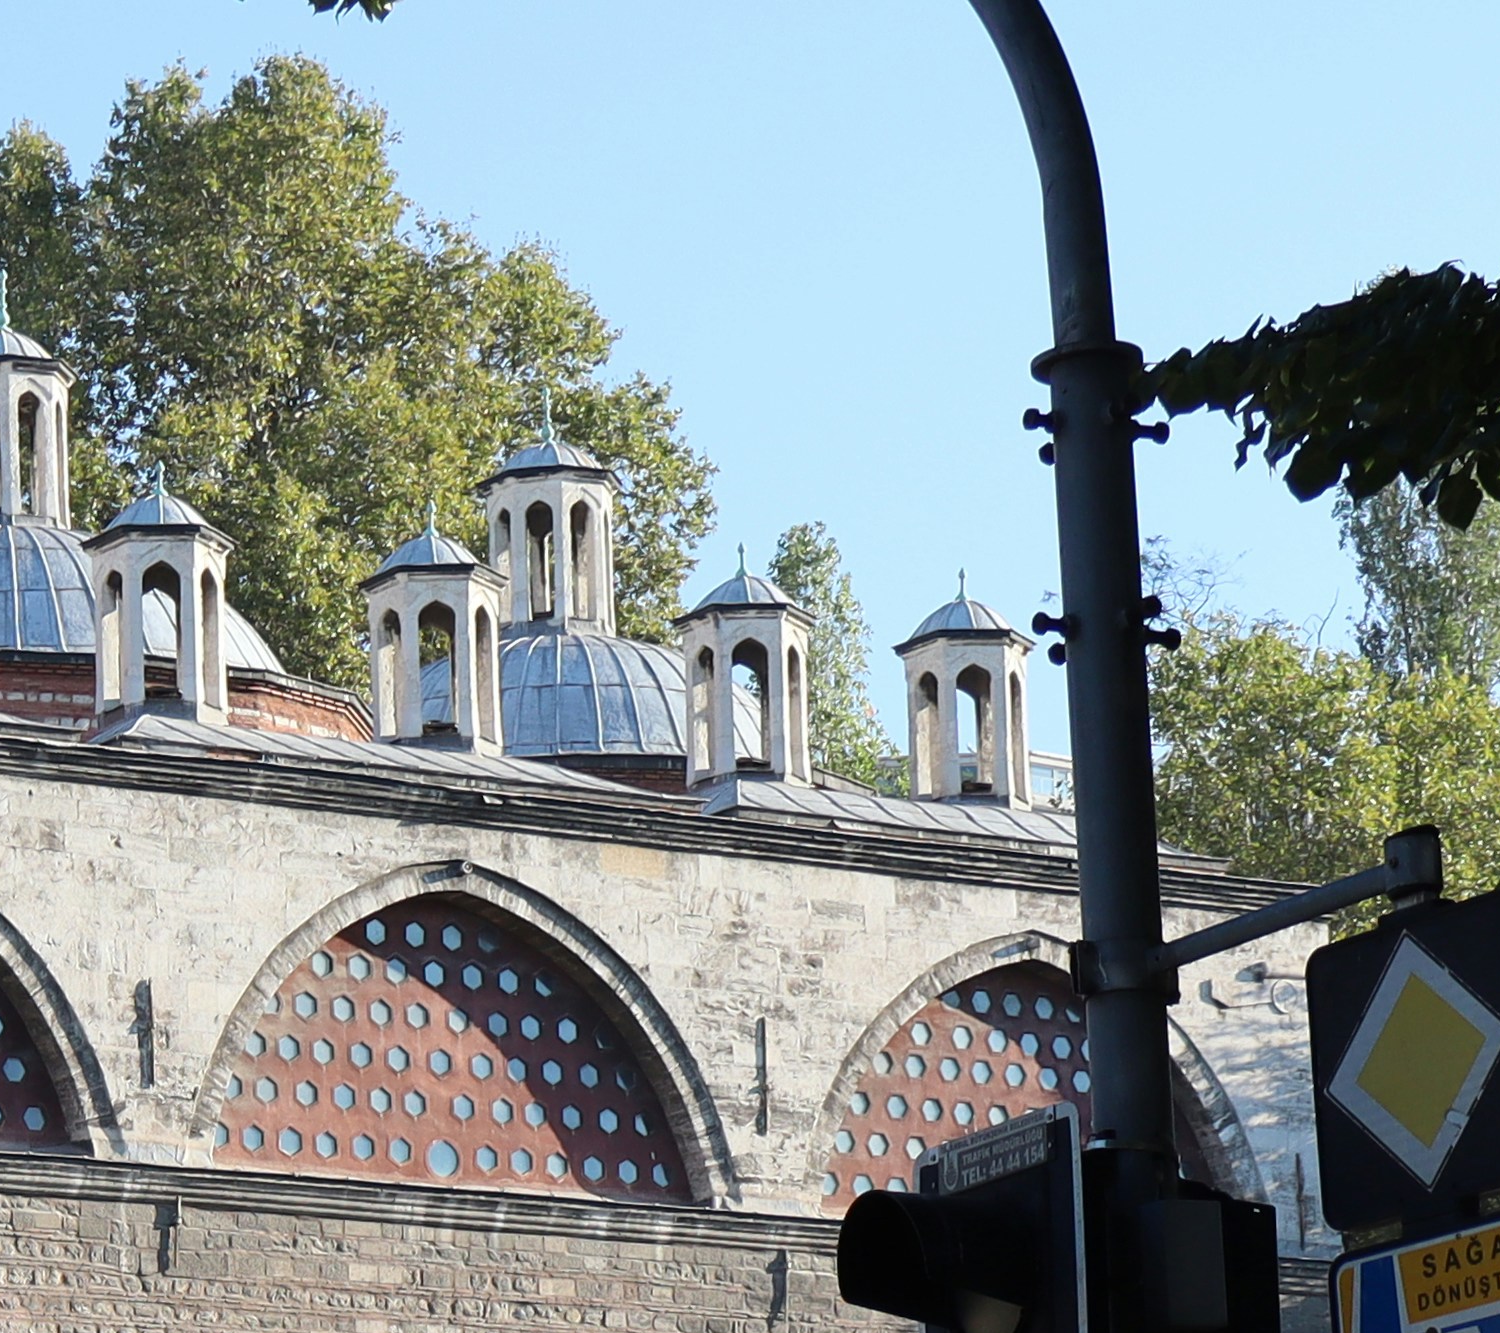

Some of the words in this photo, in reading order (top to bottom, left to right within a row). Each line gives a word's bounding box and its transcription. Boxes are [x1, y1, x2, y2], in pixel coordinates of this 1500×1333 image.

[962, 1167, 986, 1188] TEL:
[989, 1159, 1004, 1177] 44
[1006, 1153, 1021, 1170] 44
[1024, 1142, 1044, 1166] 154
